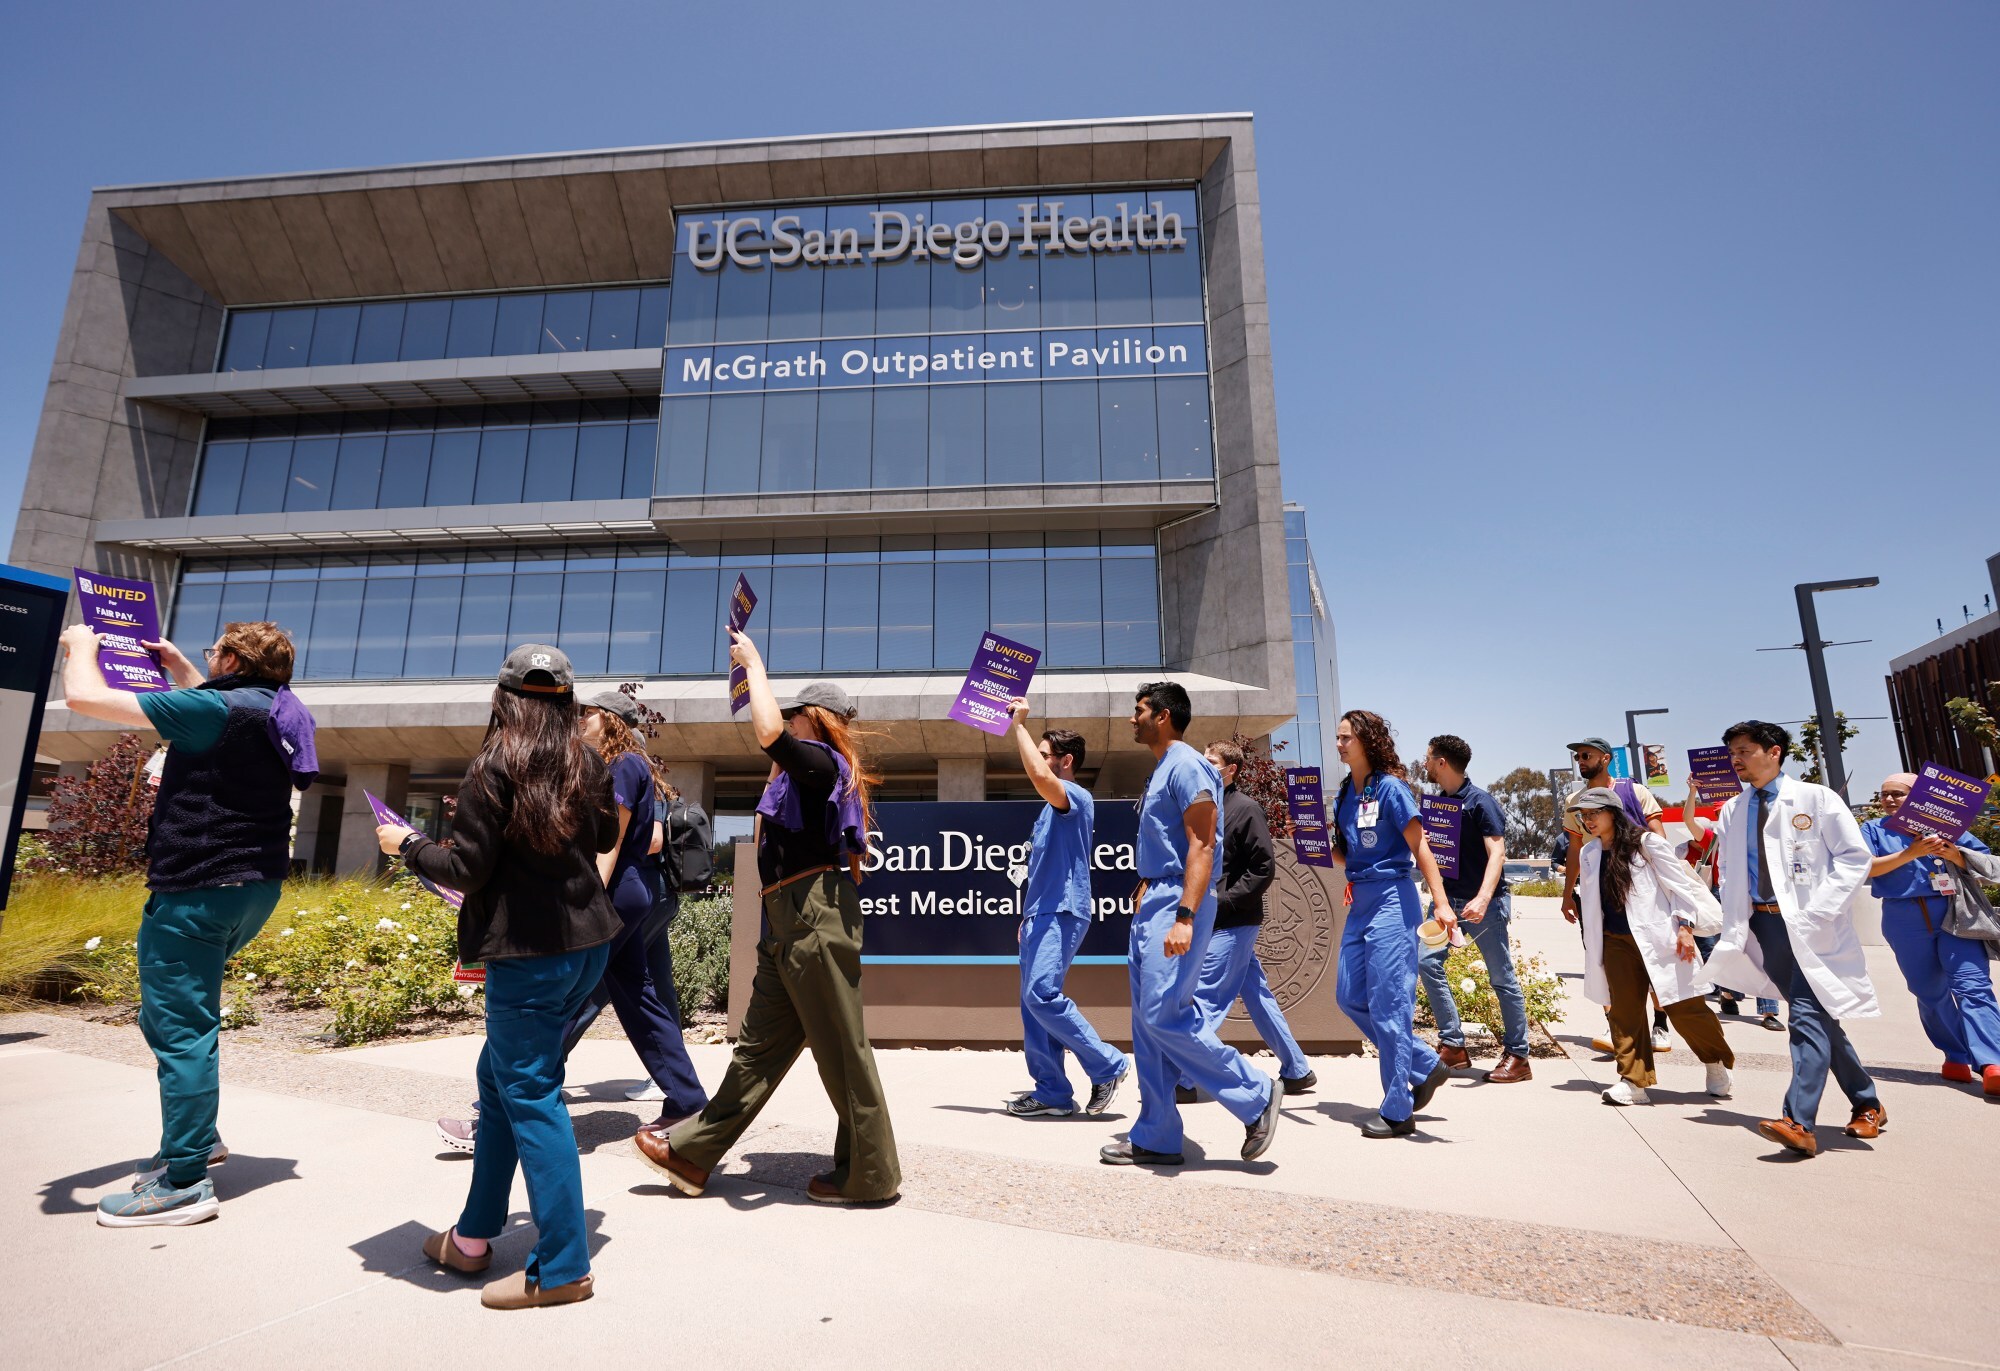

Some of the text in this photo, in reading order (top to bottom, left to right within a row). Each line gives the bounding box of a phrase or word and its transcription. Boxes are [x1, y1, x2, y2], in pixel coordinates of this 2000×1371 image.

[684, 201, 1187, 268] UC San Diego Health
[682, 338, 1188, 382] McGrath Outpatient Pavilion
[94, 584, 146, 602] UNITED
[0, 604, 28, 614] ccess
[96, 606, 136, 622] FAIR PAY,
[105, 633, 136, 644] BENEFIT
[995, 644, 1033, 664] UNITED
[113, 664, 162, 678] WORKPLACE
[987, 660, 1003, 671] FAIR
[123, 672, 152, 682] SAFETY
[983, 679, 1009, 693] BENEFIT
[968, 700, 1009, 719] WORKPLACE
[970, 708, 996, 720] SAFETY
[1295, 775, 1318, 784] UNITED
[1938, 773, 1982, 793] UNITED
[1929, 786, 1946, 797] FAIR
[1431, 802, 1458, 812] UNITED
[1924, 802, 1955, 816] BENEFIT
[1910, 802, 1962, 827] PROTECTIONS,
[1300, 839, 1327, 847] WORKPLACE
[860, 831, 934, 872] San
[938, 830, 1028, 882] Dieg
[859, 894, 900, 916] est
[910, 889, 1022, 916] Medical
[1273, 845, 1330, 962] ALIFORNIA
